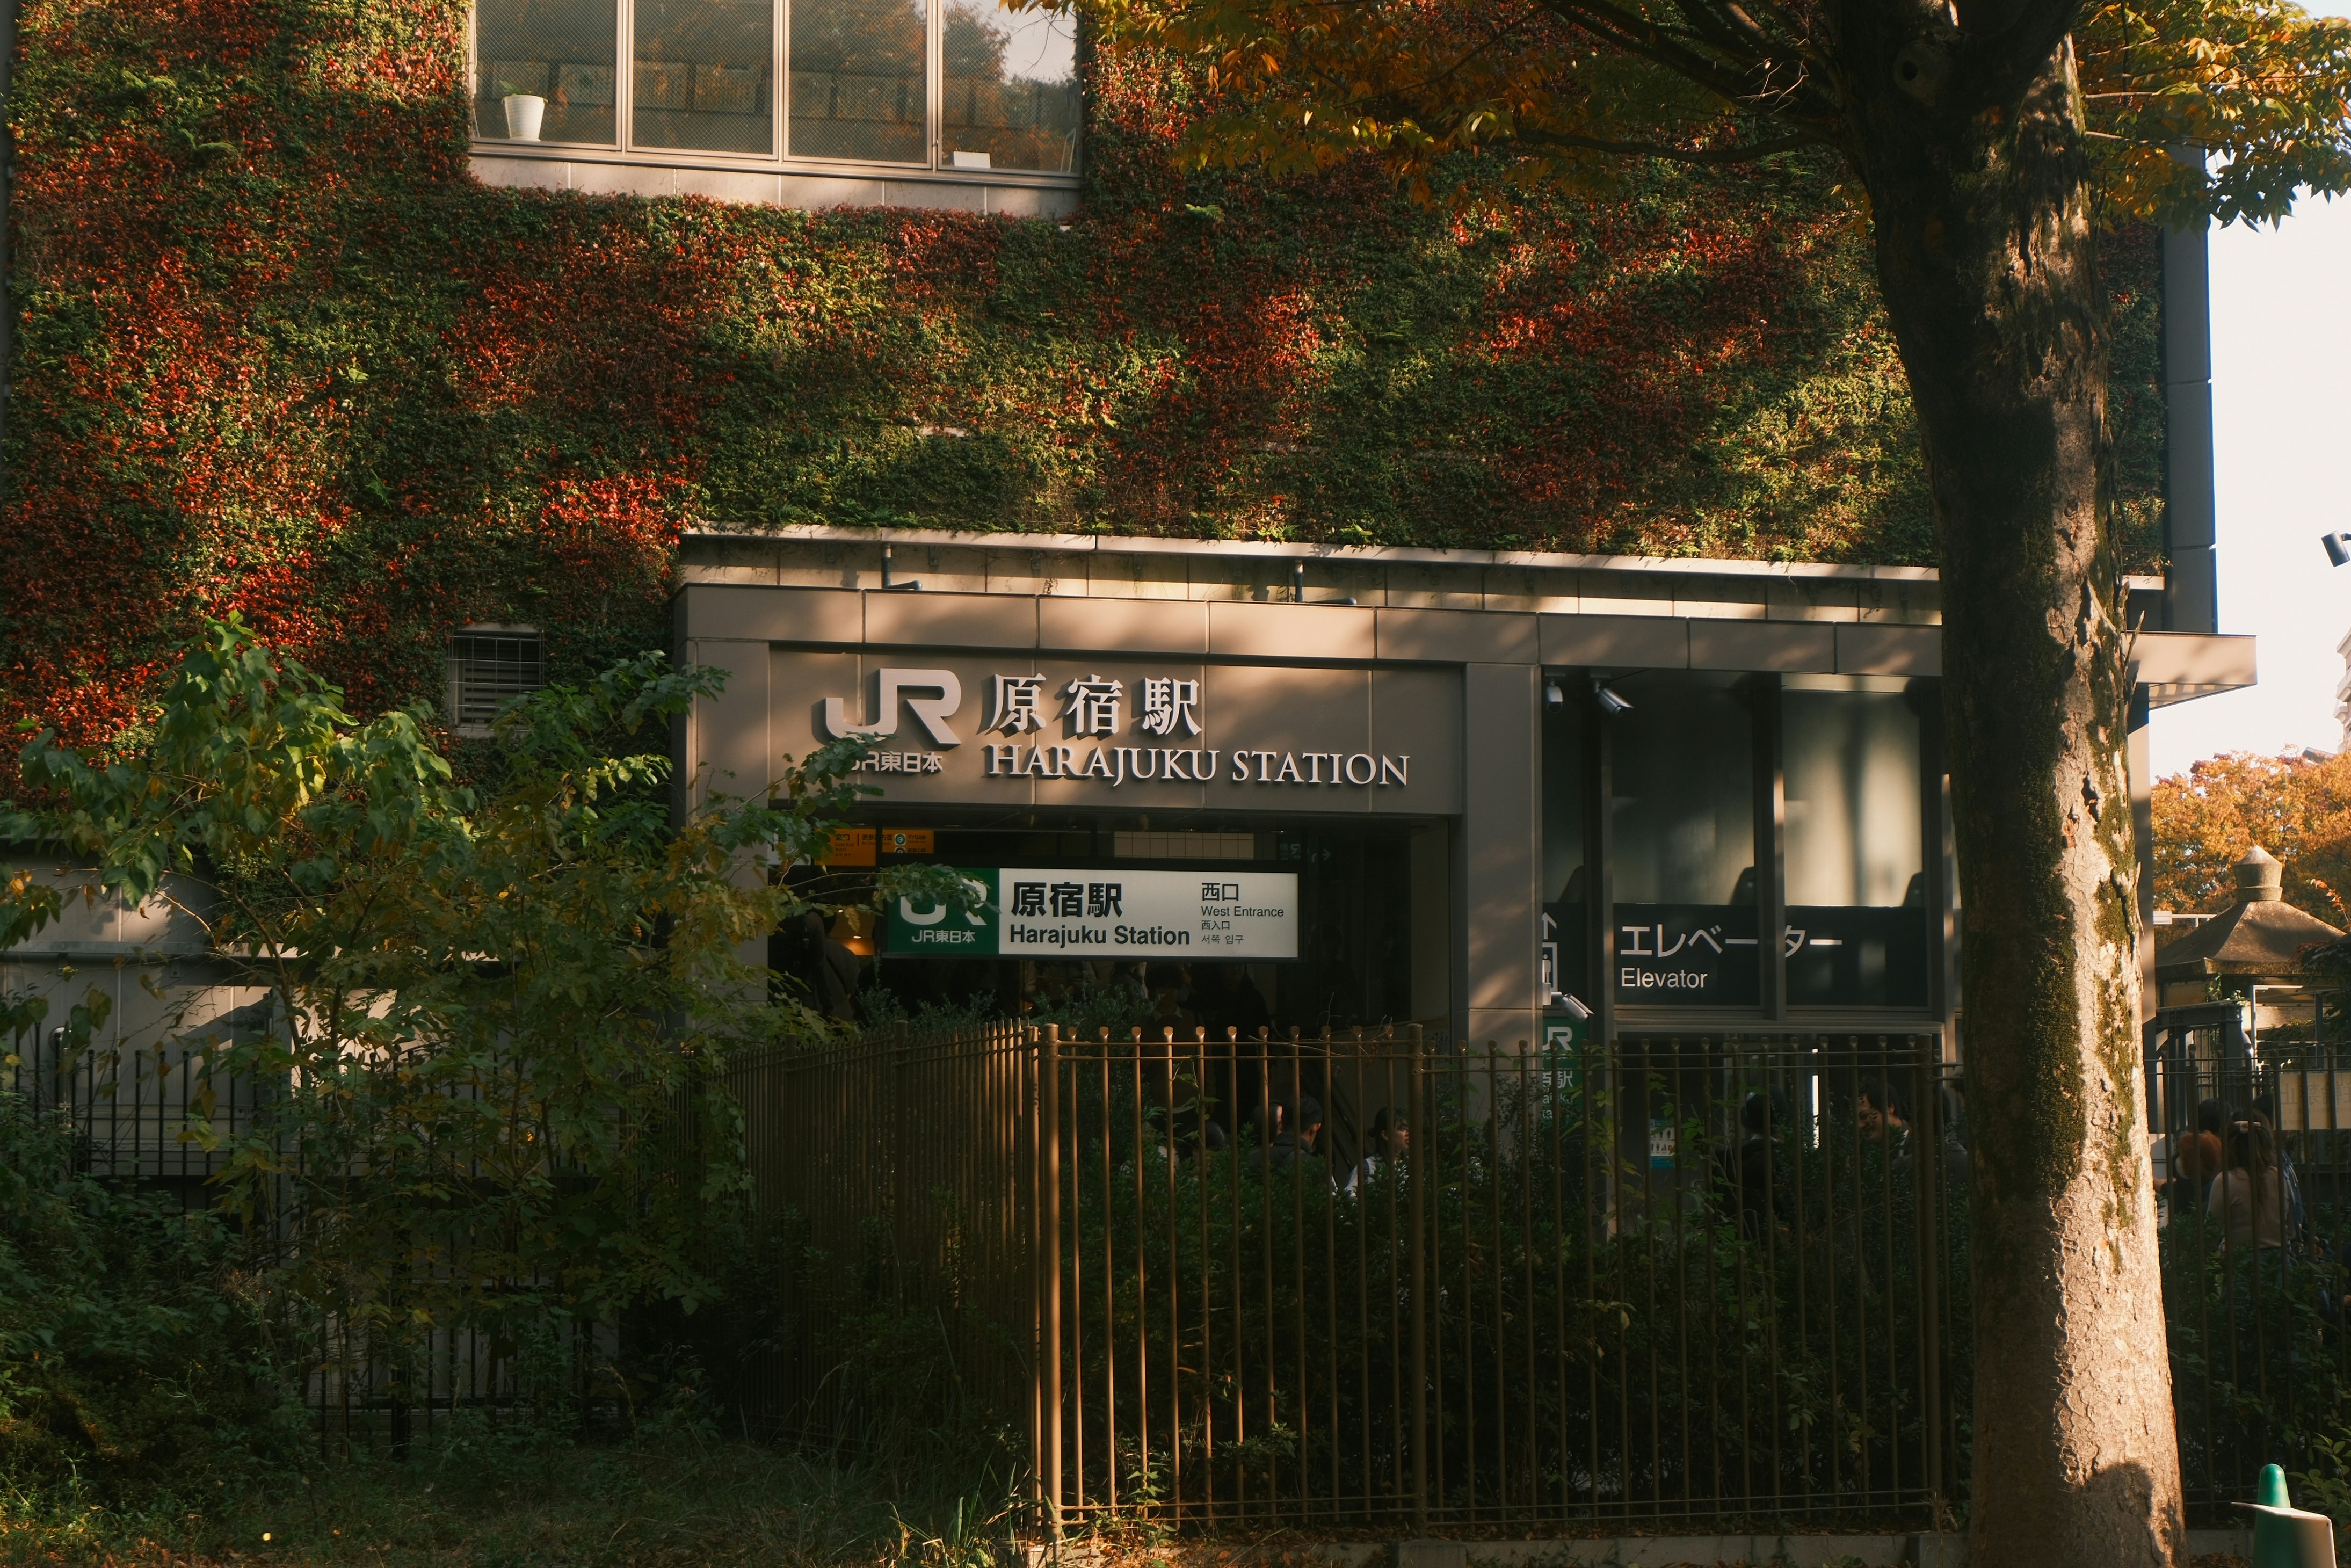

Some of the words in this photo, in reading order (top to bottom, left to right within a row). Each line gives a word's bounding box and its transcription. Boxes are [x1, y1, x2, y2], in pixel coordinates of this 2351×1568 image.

[826, 669, 962, 744] JR
[990, 673, 1202, 735] 原宿駅
[989, 744, 1220, 787] HARAJUKU
[1232, 750, 1410, 786] STATION
[1011, 881, 1123, 917] 原宿駅
[1201, 882, 1239, 902] 西口
[1201, 905, 1230, 917] West
[1234, 906, 1284, 917] Entrance
[1201, 920, 1230, 930] 西入口
[911, 930, 976, 943] JR東日本
[1010, 924, 1106, 949] Harajuku
[1114, 925, 1190, 945] Station
[1225, 934, 1244, 945] 입구
[1621, 967, 1708, 988] Elevator
